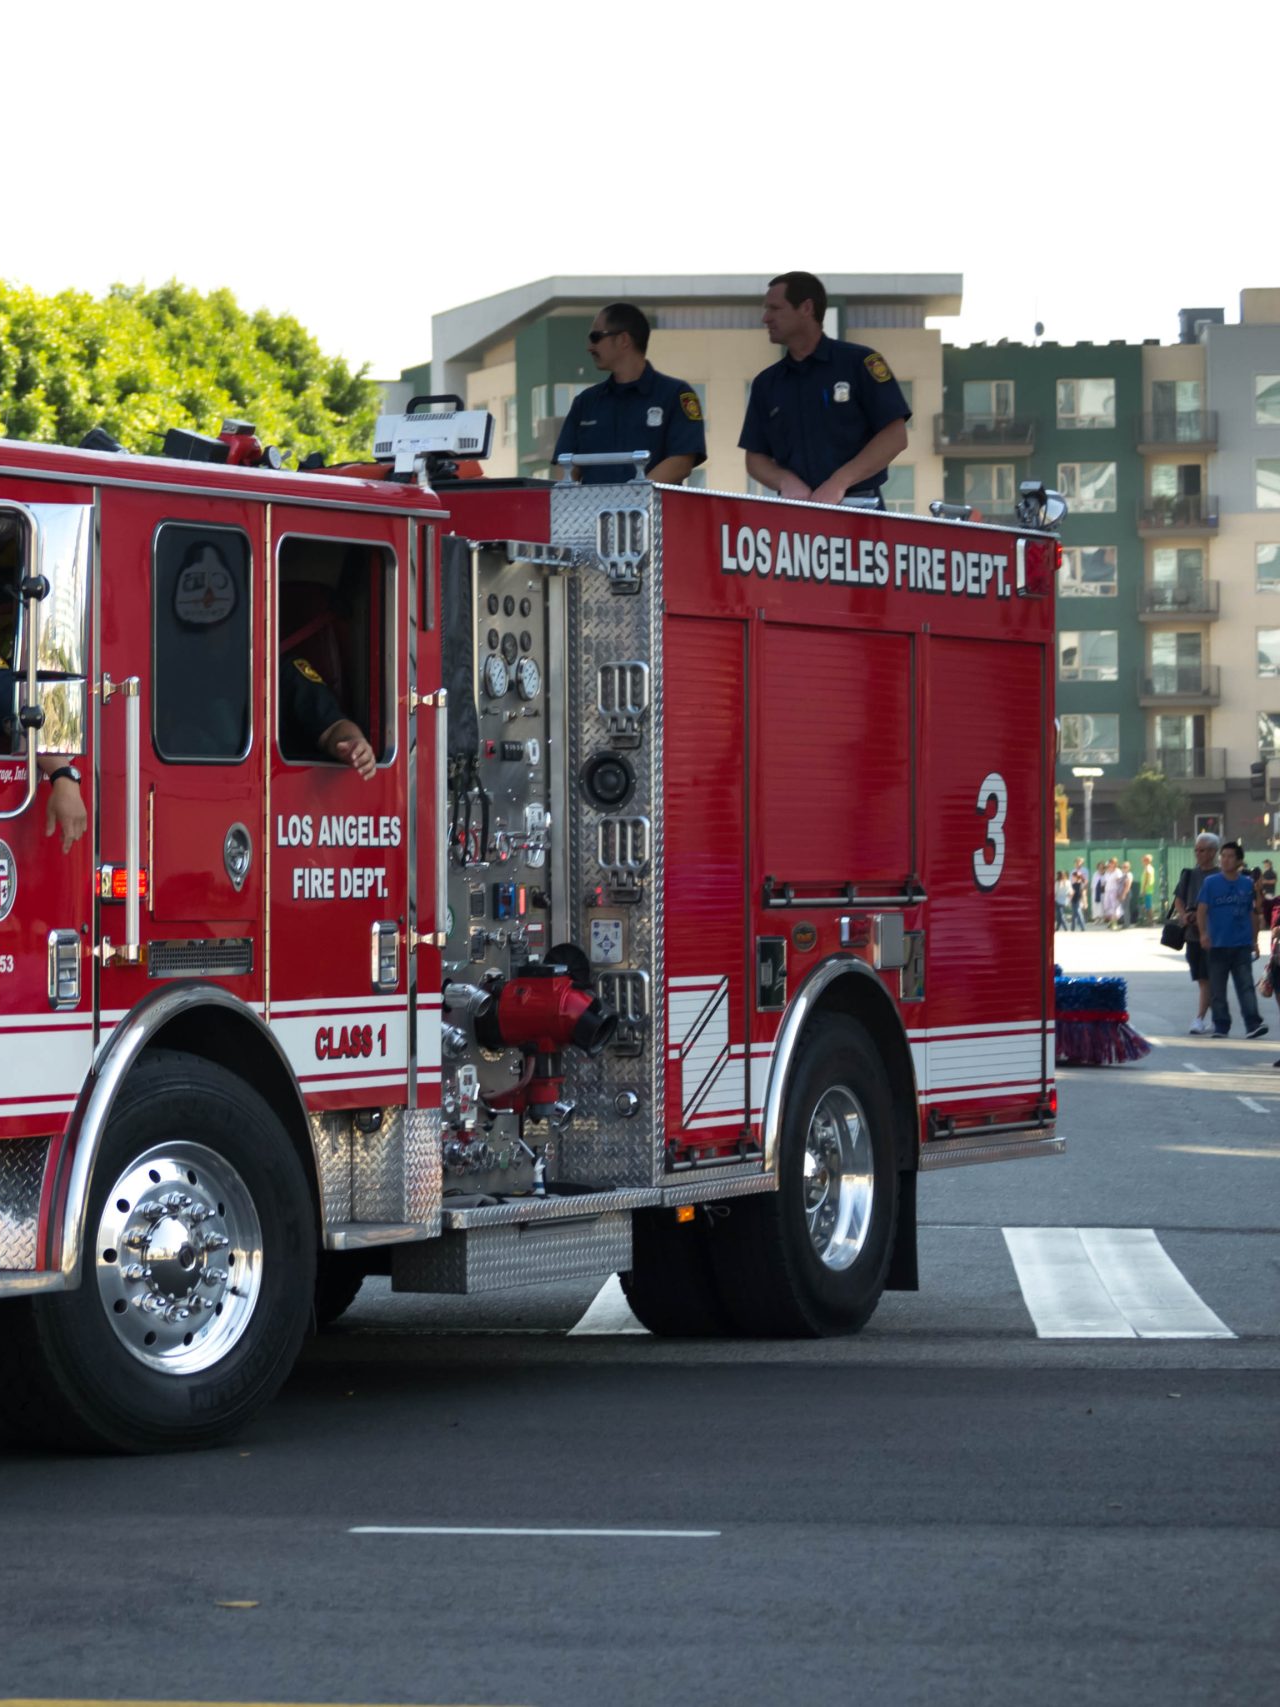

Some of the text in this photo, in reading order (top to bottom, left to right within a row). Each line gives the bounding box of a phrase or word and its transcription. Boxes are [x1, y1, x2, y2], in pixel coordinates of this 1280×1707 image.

[721, 523, 1012, 600] LOS ANGELES FIRE DEPT.
[276, 814, 402, 848] LOS ANGELES
[972, 771, 1009, 893] 3
[293, 867, 389, 899] FIRE DEPT.
[315, 1023, 387, 1061] CLASS 1
